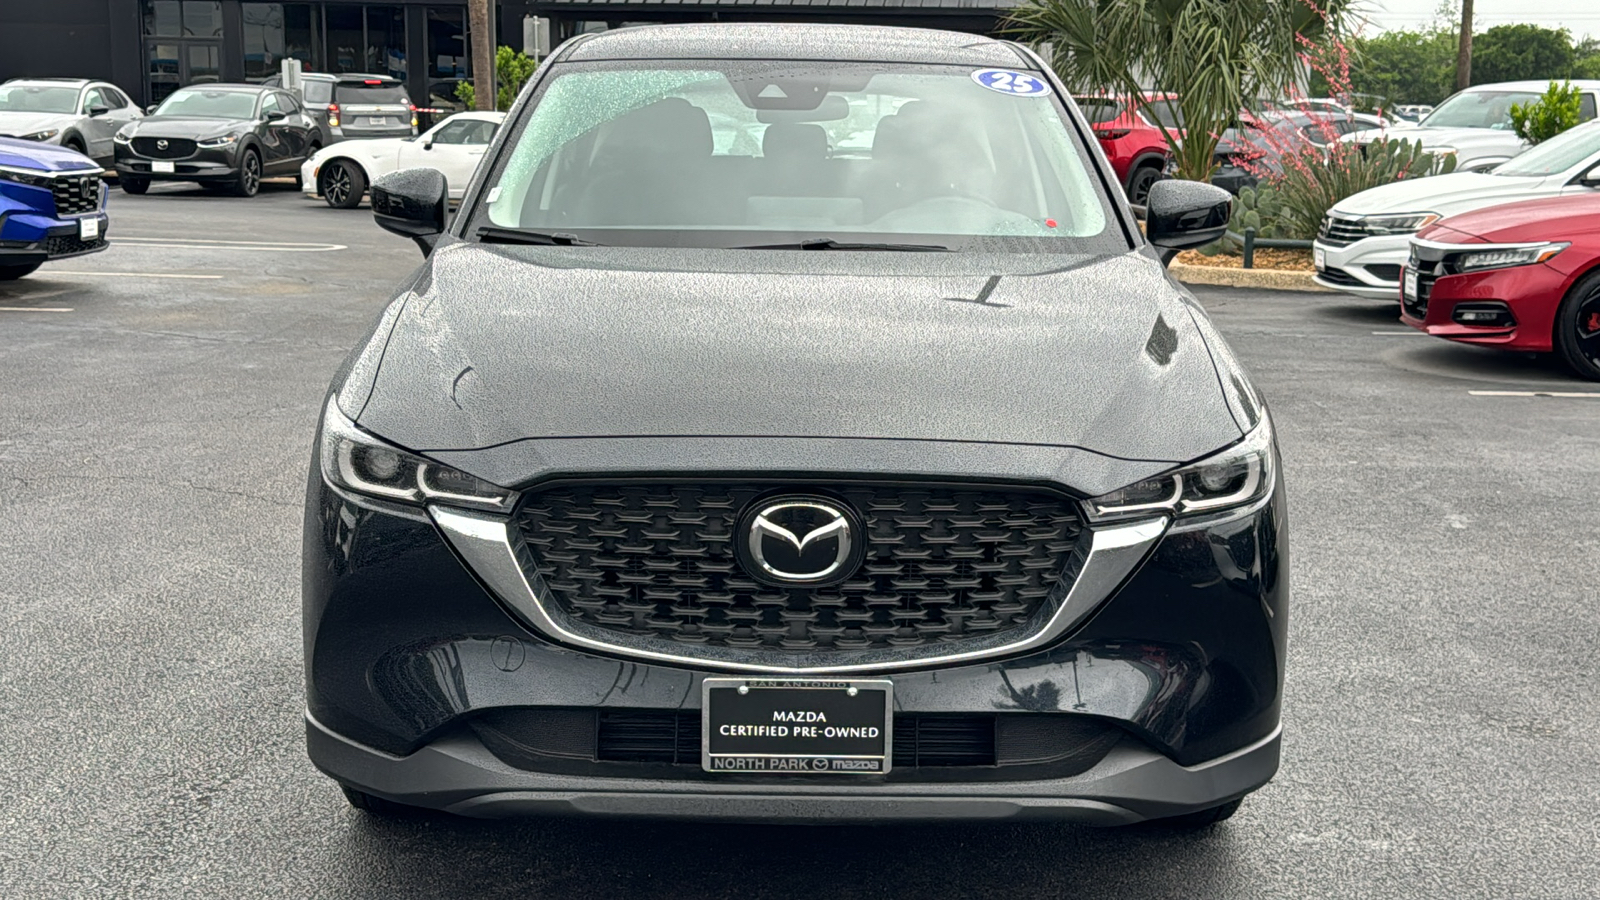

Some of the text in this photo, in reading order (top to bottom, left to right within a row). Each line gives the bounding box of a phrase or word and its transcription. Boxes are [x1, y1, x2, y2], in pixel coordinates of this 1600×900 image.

[991, 72, 1033, 93] 25
[772, 711, 827, 722] MAZDA
[719, 724, 879, 738] CERTIFIED PRE-OWNED
[714, 758, 879, 770] NORTH PARK mazda
